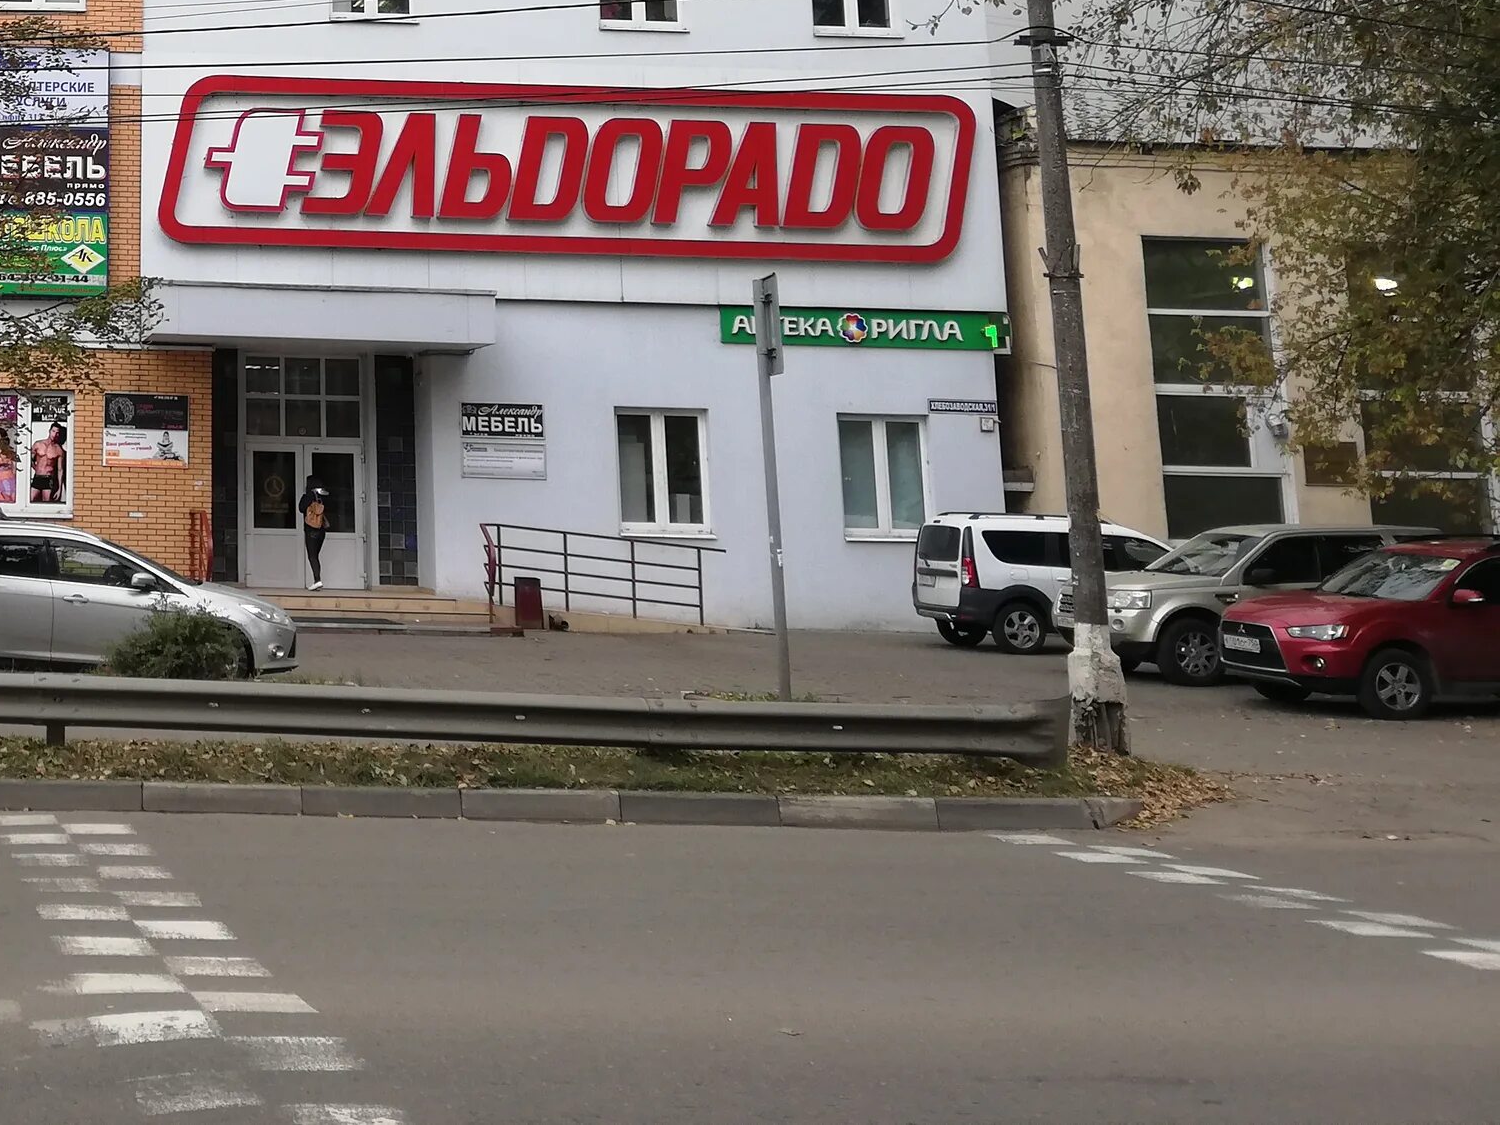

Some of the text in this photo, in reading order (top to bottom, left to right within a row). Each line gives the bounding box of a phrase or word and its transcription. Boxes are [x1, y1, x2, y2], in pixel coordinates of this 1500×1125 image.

[66, 182, 105, 190] прямо
[731, 315, 964, 342] АЕКА РИГЛА
[477, 405, 543, 419] Александр
[462, 415, 543, 433] МЕБЕЛЬ
